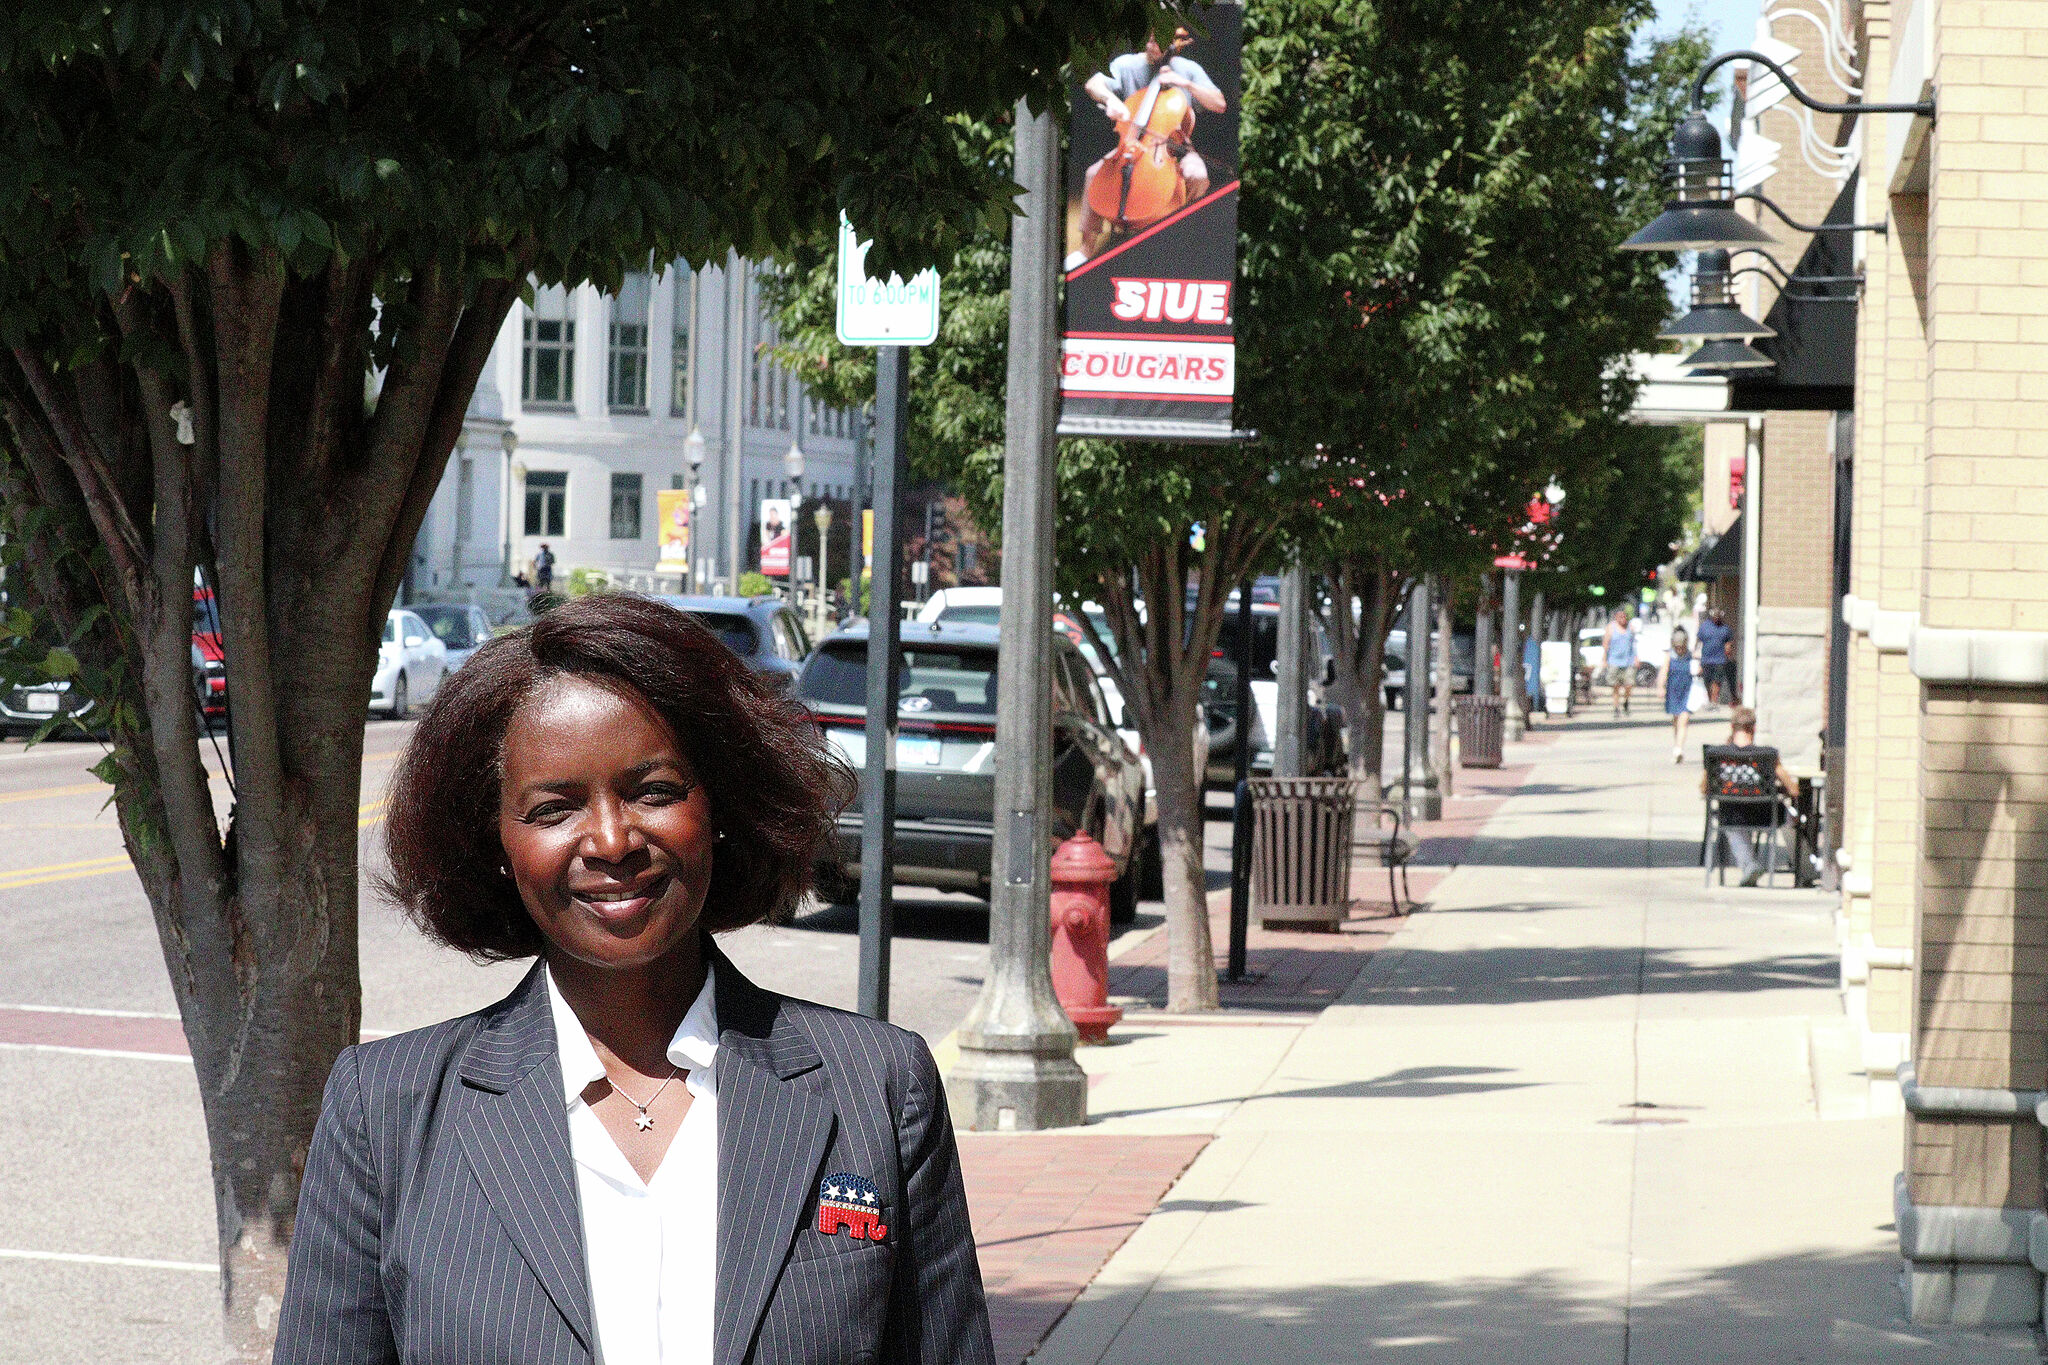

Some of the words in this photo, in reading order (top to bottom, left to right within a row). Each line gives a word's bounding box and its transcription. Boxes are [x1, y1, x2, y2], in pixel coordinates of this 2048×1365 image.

[848, 284, 866, 305] TO
[873, 284, 929, 305] 6:00PM
[1111, 278, 1230, 323] SIUE
[1062, 352, 1225, 382] COUGARS
